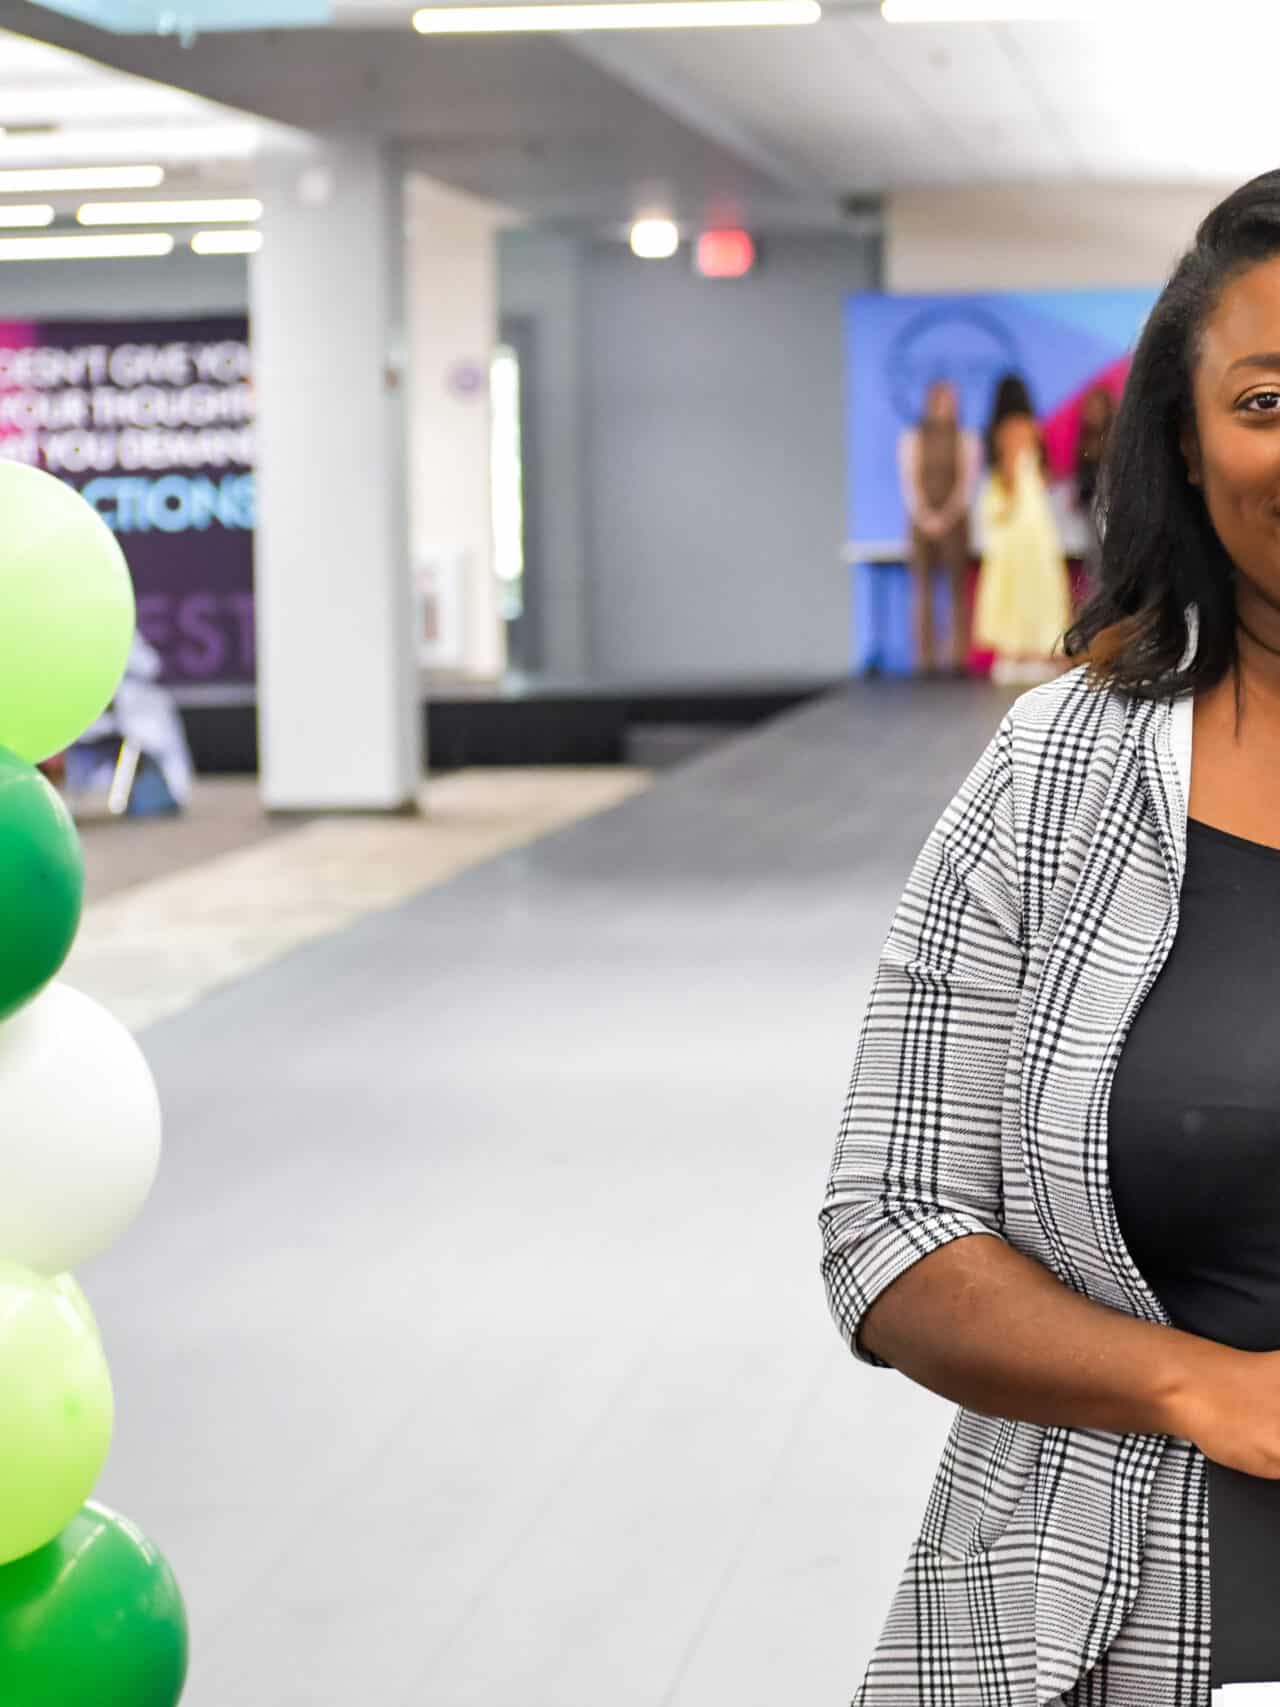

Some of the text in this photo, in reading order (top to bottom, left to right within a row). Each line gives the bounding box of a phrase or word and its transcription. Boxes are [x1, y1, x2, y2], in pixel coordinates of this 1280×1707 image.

[109, 342, 190, 386] GIVE
[43, 430, 116, 473] YOU
[78, 472, 255, 532] CTIONS
